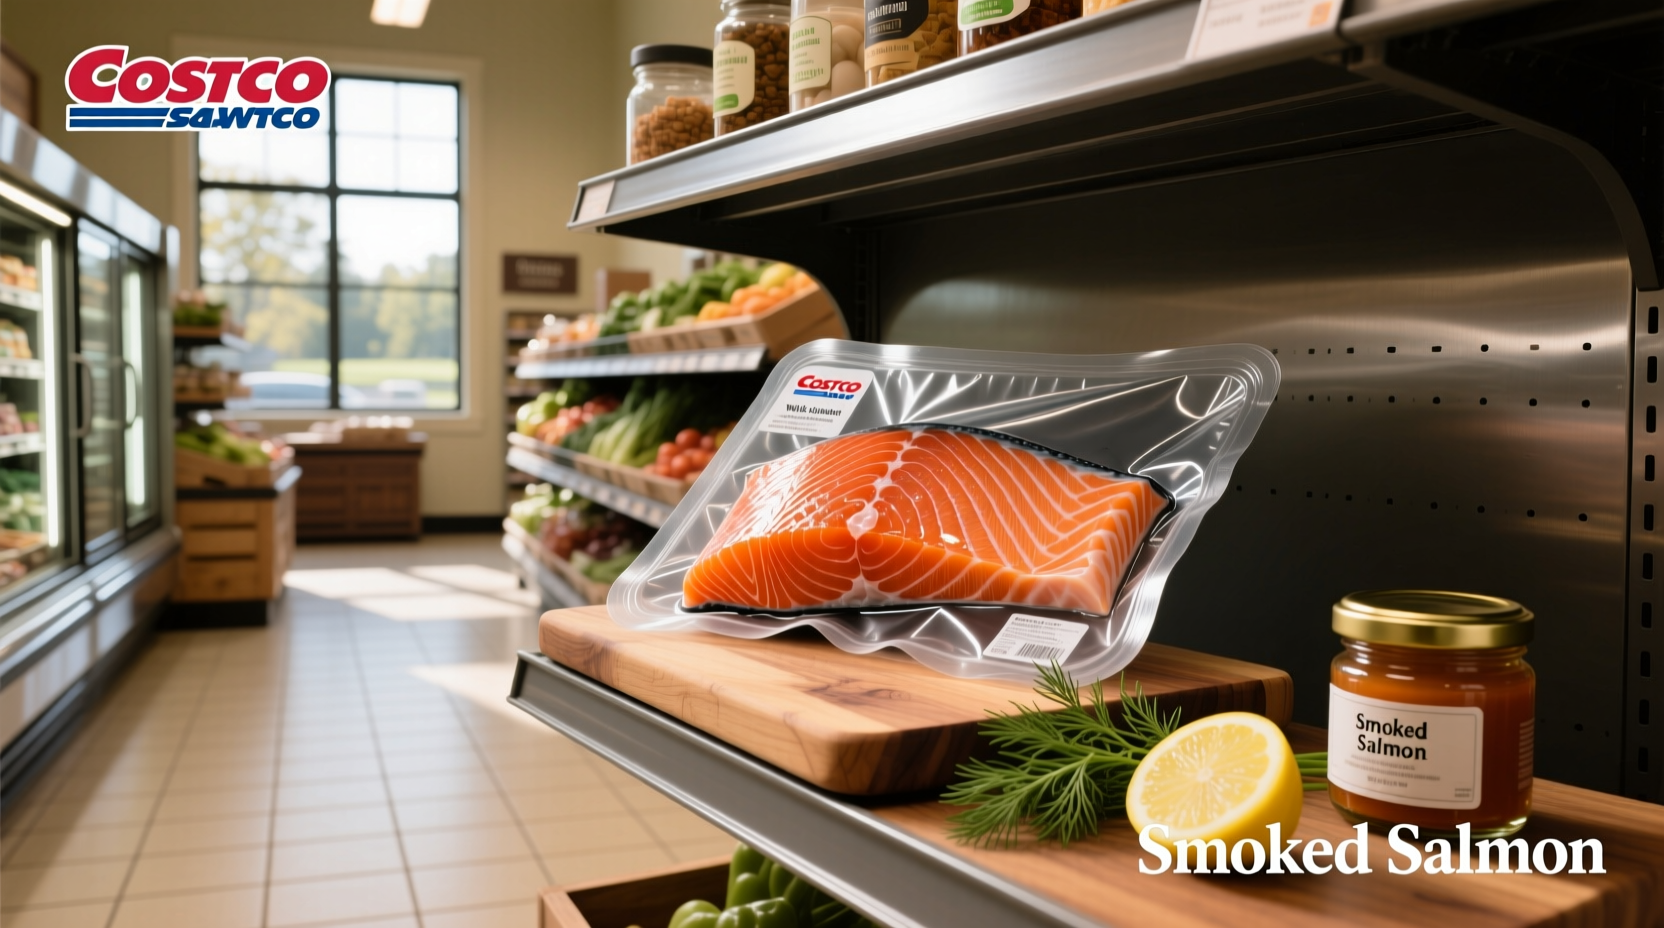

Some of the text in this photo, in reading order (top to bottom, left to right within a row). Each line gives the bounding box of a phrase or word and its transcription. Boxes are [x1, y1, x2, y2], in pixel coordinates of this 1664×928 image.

[797, 374, 862, 393] COSTCO
[1356, 713, 1428, 740] Smoked
[1357, 734, 1428, 761] Salmon
